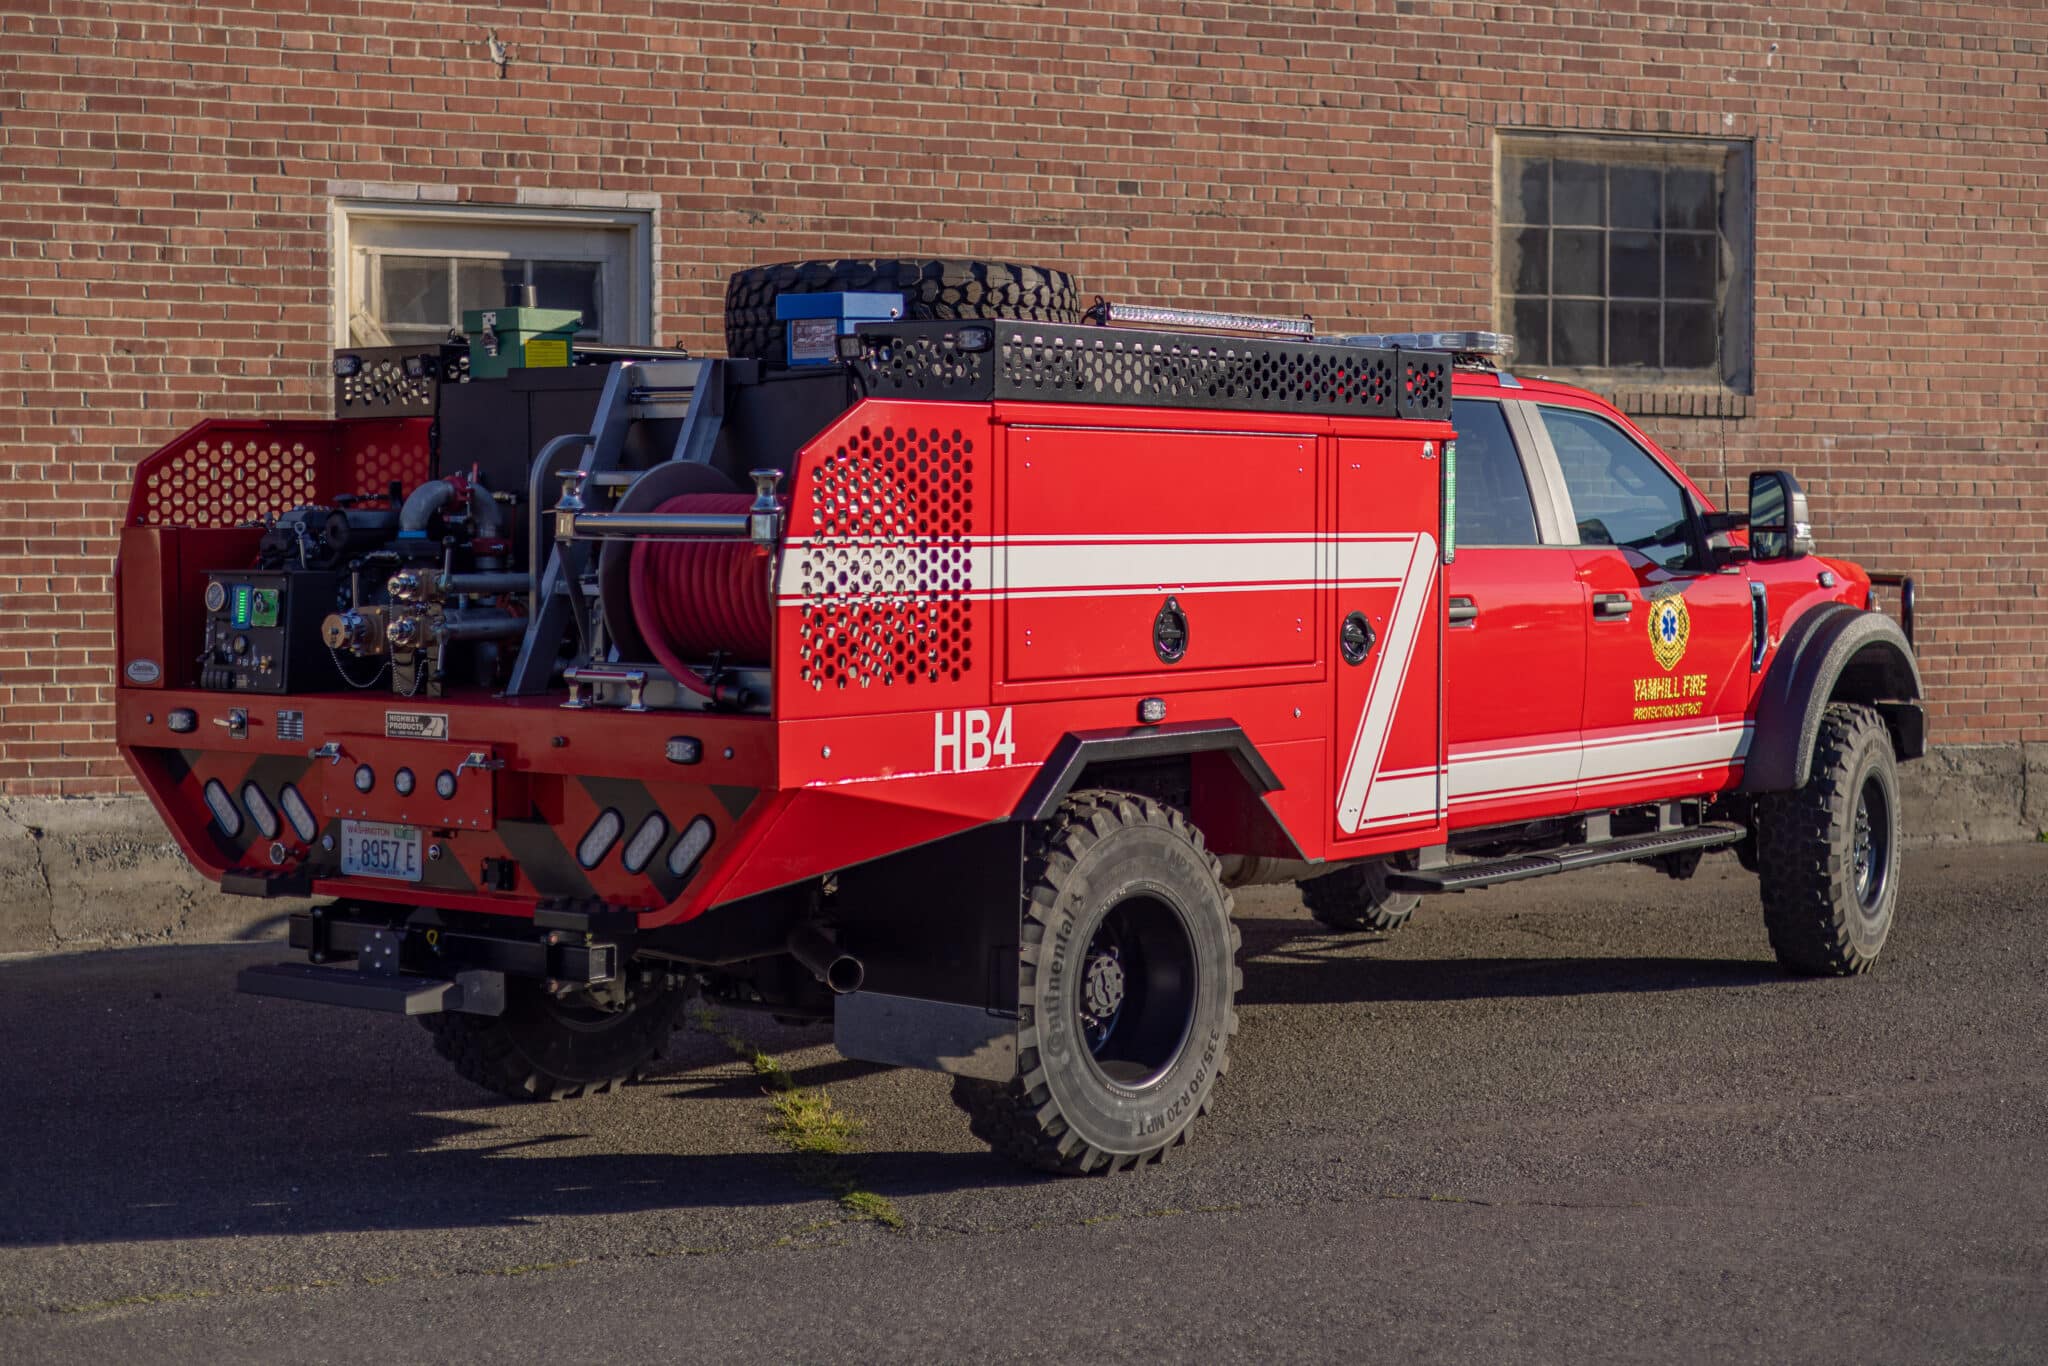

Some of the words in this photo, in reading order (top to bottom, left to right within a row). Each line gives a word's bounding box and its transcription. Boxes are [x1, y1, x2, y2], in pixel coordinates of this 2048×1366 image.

[1634, 677, 1680, 701] YAMHILL
[1683, 674, 1708, 697] FIRE
[389, 714, 419, 723] HIGHWAY
[389, 722, 424, 731] PRODUCTS
[934, 706, 1016, 772] HB4
[361, 839, 401, 870] 8957
[1044, 907, 1076, 1058] Continental
[1136, 1114, 1166, 1137] MPT
